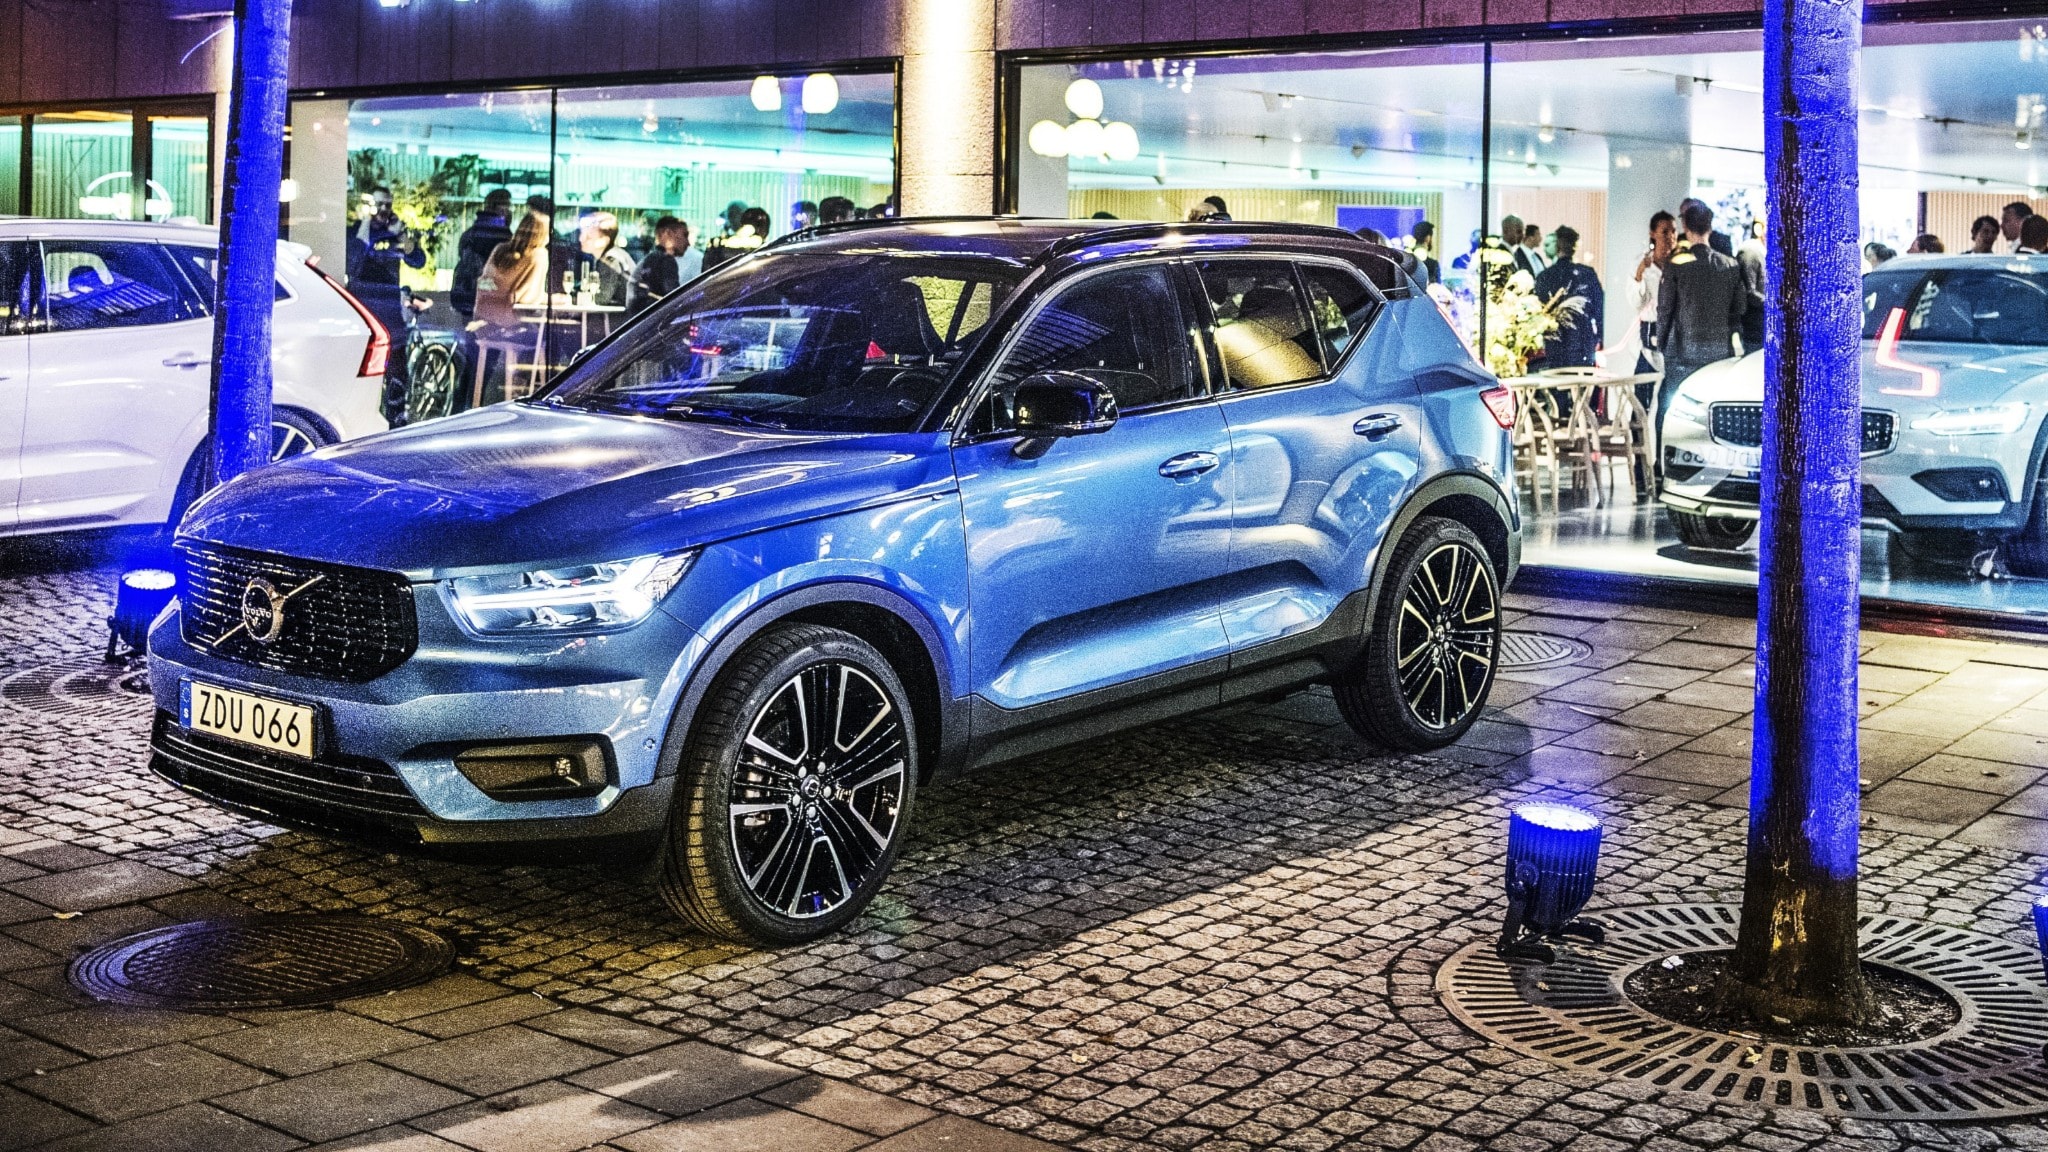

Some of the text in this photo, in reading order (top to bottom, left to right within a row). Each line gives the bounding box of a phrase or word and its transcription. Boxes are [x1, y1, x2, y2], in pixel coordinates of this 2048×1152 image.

[245, 606, 272, 619] VOLVO
[200, 690, 300, 747] ZDU 066
